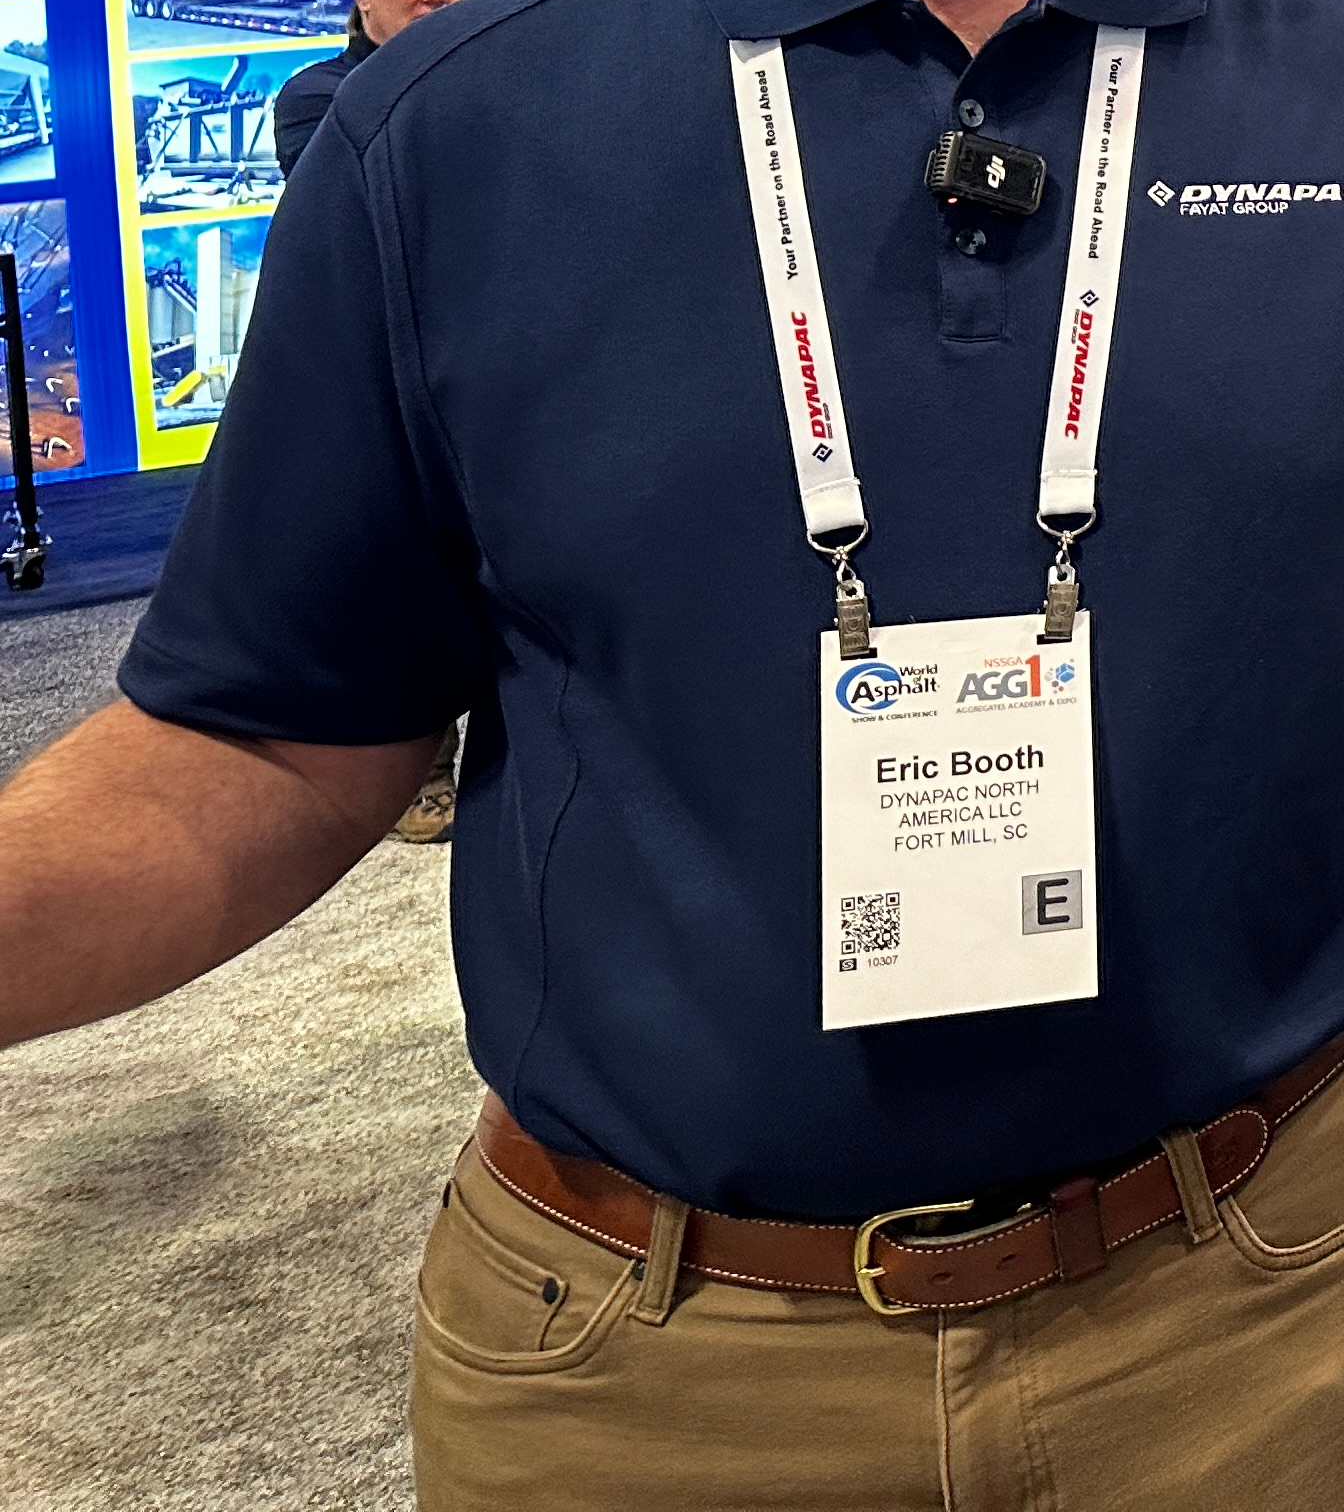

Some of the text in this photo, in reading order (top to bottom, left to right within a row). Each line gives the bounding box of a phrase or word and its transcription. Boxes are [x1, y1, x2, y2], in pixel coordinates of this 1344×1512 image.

[1088, 57, 1123, 259] Your Partner on the Road Ahead
[755, 69, 799, 280] Your Partner on the Road Ahead
[1180, 201, 1289, 215] FAYAT GROUP
[791, 311, 827, 440] DYNAPAC
[1064, 310, 1093, 440] DYNAPAC
[900, 664, 938, 676] World
[984, 656, 1023, 668] NSSGA
[851, 677, 938, 704] Asphalt
[956, 654, 1041, 704] AGG1
[886, 710, 938, 721] CONFERENCE
[956, 703, 1006, 714] AGGREGATES
[1007, 699, 1046, 710] ACADEMY
[1056, 696, 1077, 705] EXPO
[877, 744, 1044, 783] Eric Booth
[880, 779, 1039, 809] DYNAPAC NORTH
[899, 801, 1022, 828] AMERICA LLC
[894, 823, 1028, 852] FORT MILL, SC
[1037, 877, 1070, 926] E
[867, 954, 899, 968] 10307
